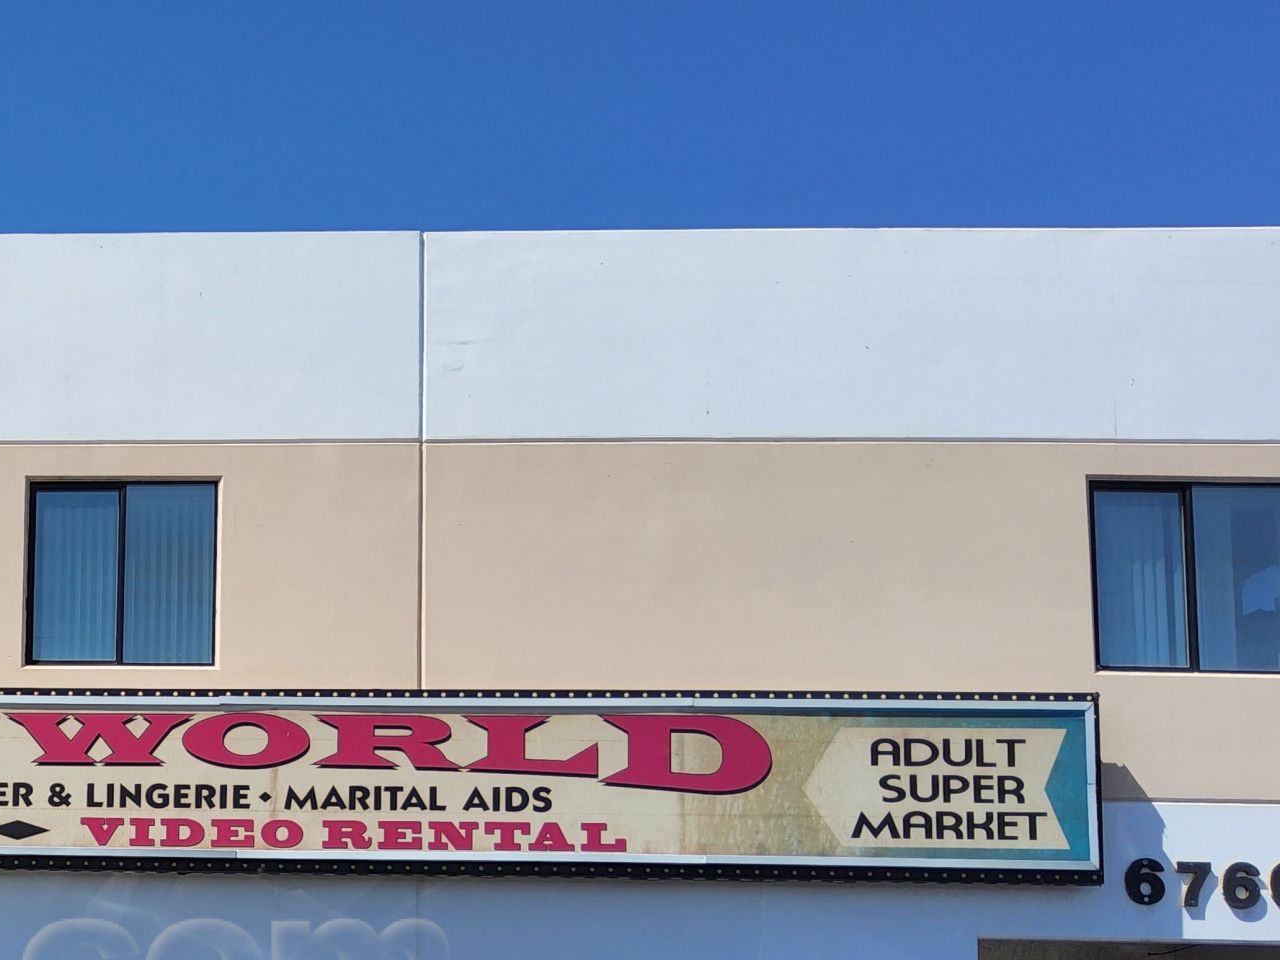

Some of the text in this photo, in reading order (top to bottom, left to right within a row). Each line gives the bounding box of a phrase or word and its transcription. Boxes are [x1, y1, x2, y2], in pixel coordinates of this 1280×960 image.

[5, 712, 772, 796] WORLD
[869, 738, 1027, 768] ADULT
[49, 783, 72, 808] &
[86, 783, 251, 810] LINGERIE
[283, 785, 446, 812] MARITAL
[462, 786, 553, 812] AIDS
[878, 774, 1025, 805] SUPER
[81, 817, 304, 849] VIDEO
[320, 819, 627, 853] RENTAL
[851, 811, 1048, 841] MARKET
